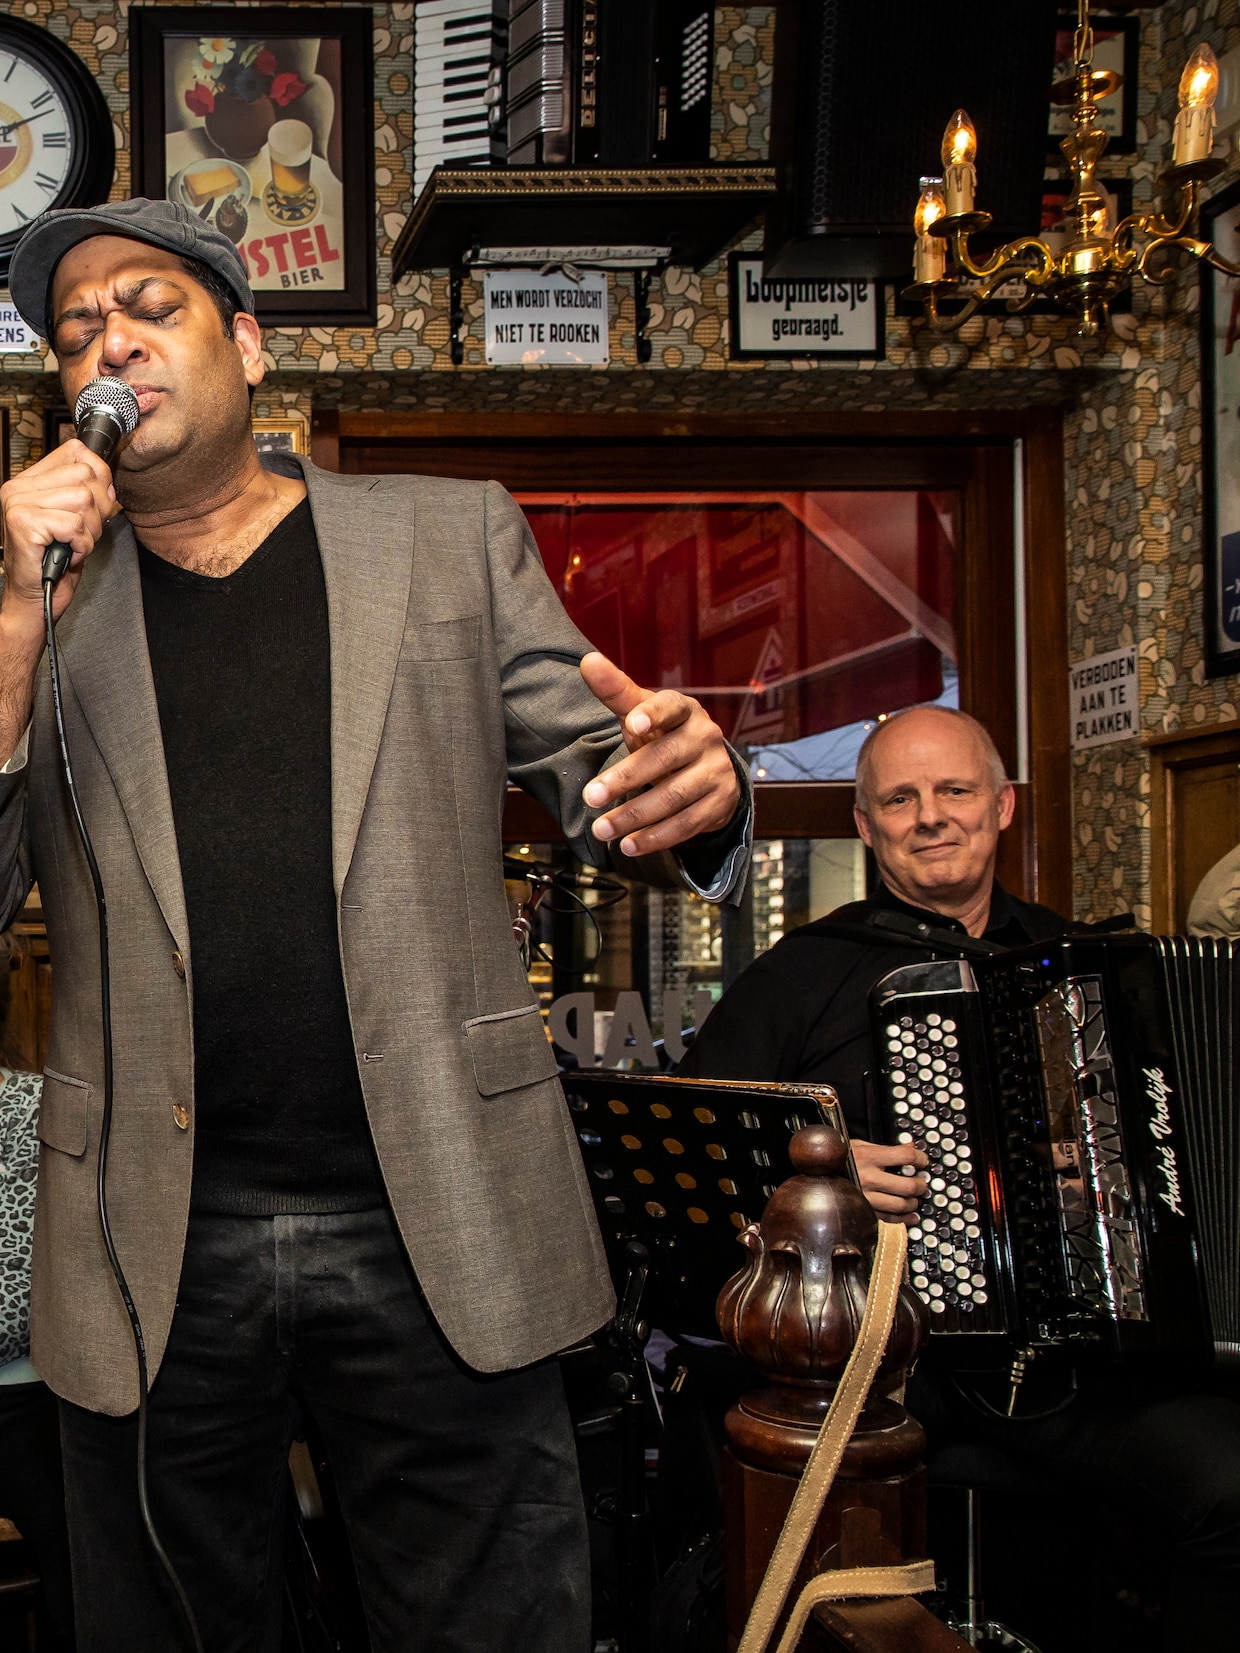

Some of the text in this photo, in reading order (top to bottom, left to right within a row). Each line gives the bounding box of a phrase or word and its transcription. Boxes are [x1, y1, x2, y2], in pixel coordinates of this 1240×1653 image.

[43, 131, 67, 148] III
[238, 223, 340, 281] STEL
[280, 267, 324, 288] BIER
[490, 289, 603, 310] MEN WORDT VERZOCHT
[495, 323, 600, 344] NIET TE ROOKEN
[1071, 655, 1135, 691] VERBODEN
[1080, 684, 1127, 714] AAN TE
[1076, 710, 1132, 741] PLAKKEN
[1142, 1066, 1186, 1217] André Vrolijk
